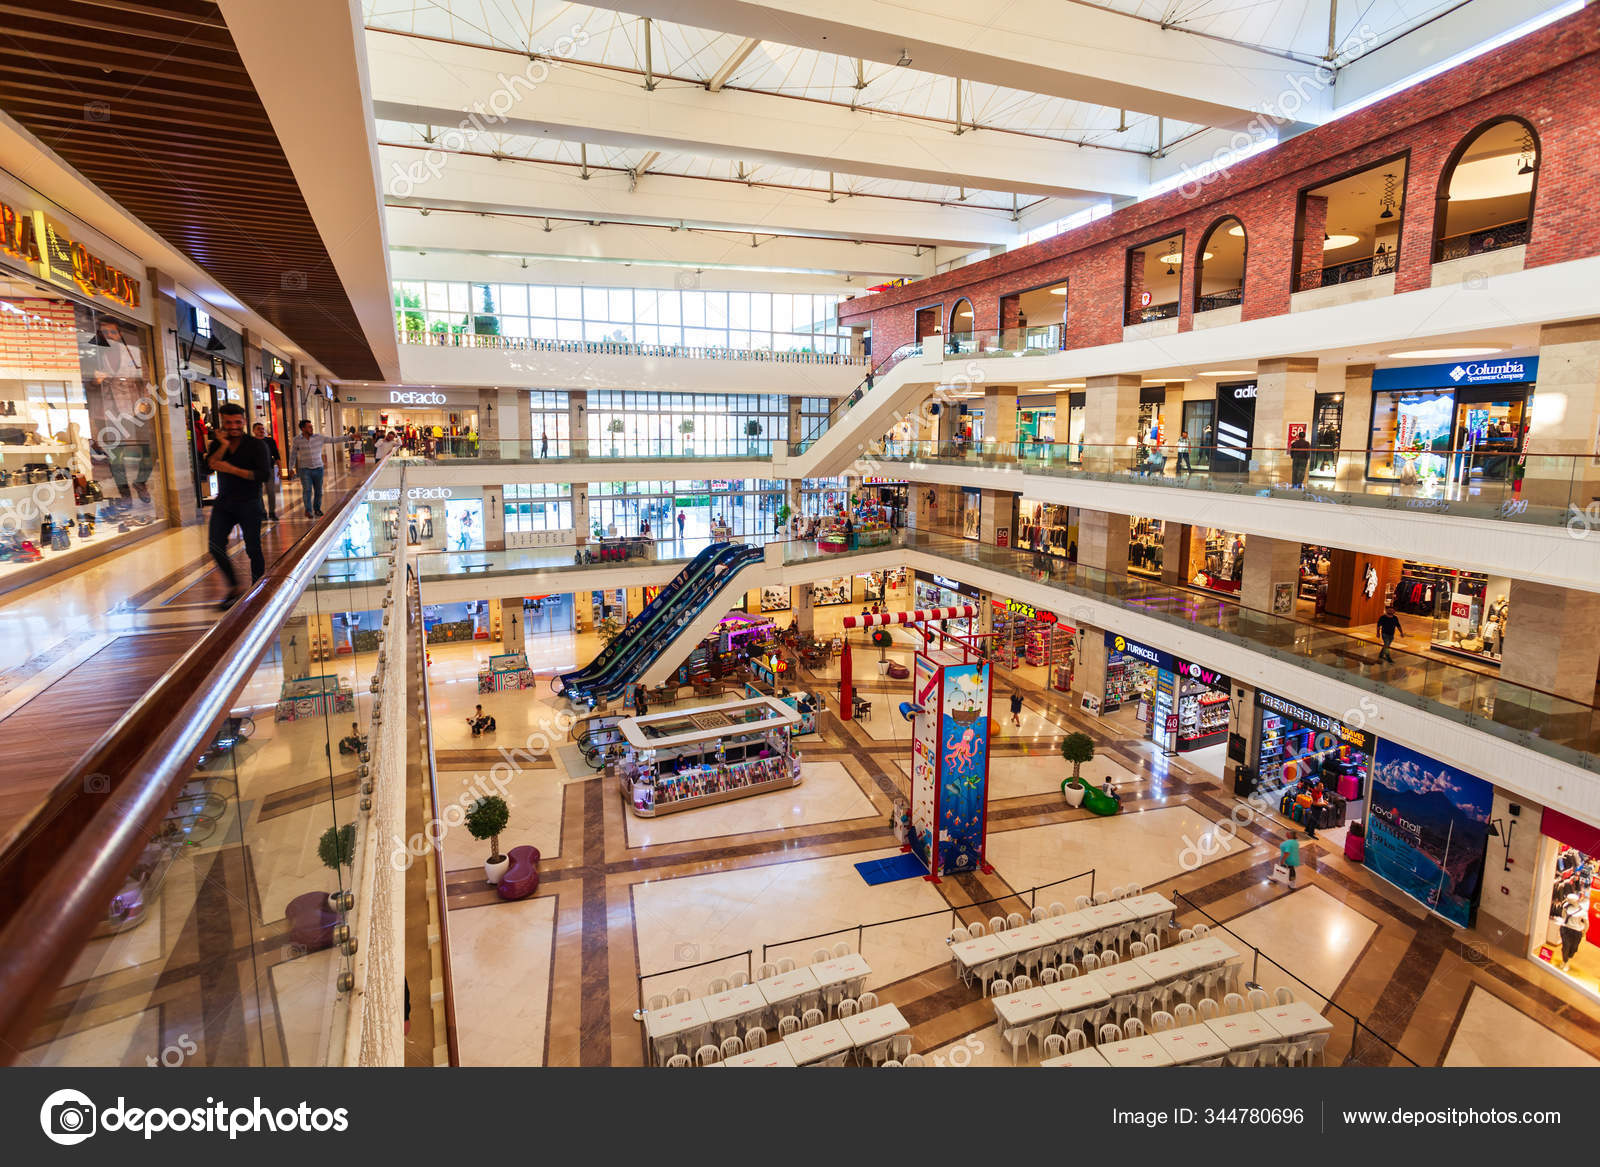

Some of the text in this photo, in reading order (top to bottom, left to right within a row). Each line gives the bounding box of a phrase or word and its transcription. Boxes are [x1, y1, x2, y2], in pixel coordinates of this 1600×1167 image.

[1466, 361, 1524, 375] Columbia
[390, 391, 447, 405] DeFacto
[407, 486, 452, 499] eFacto
[1454, 607, 1466, 616] 40
[1126, 643, 1160, 663] TURKCELL
[1166, 718, 1178, 728] 40
[1341, 726, 1366, 742] TRAVEL
[1341, 733, 1364, 748] STORE
[1372, 803, 1421, 835] nova mall
